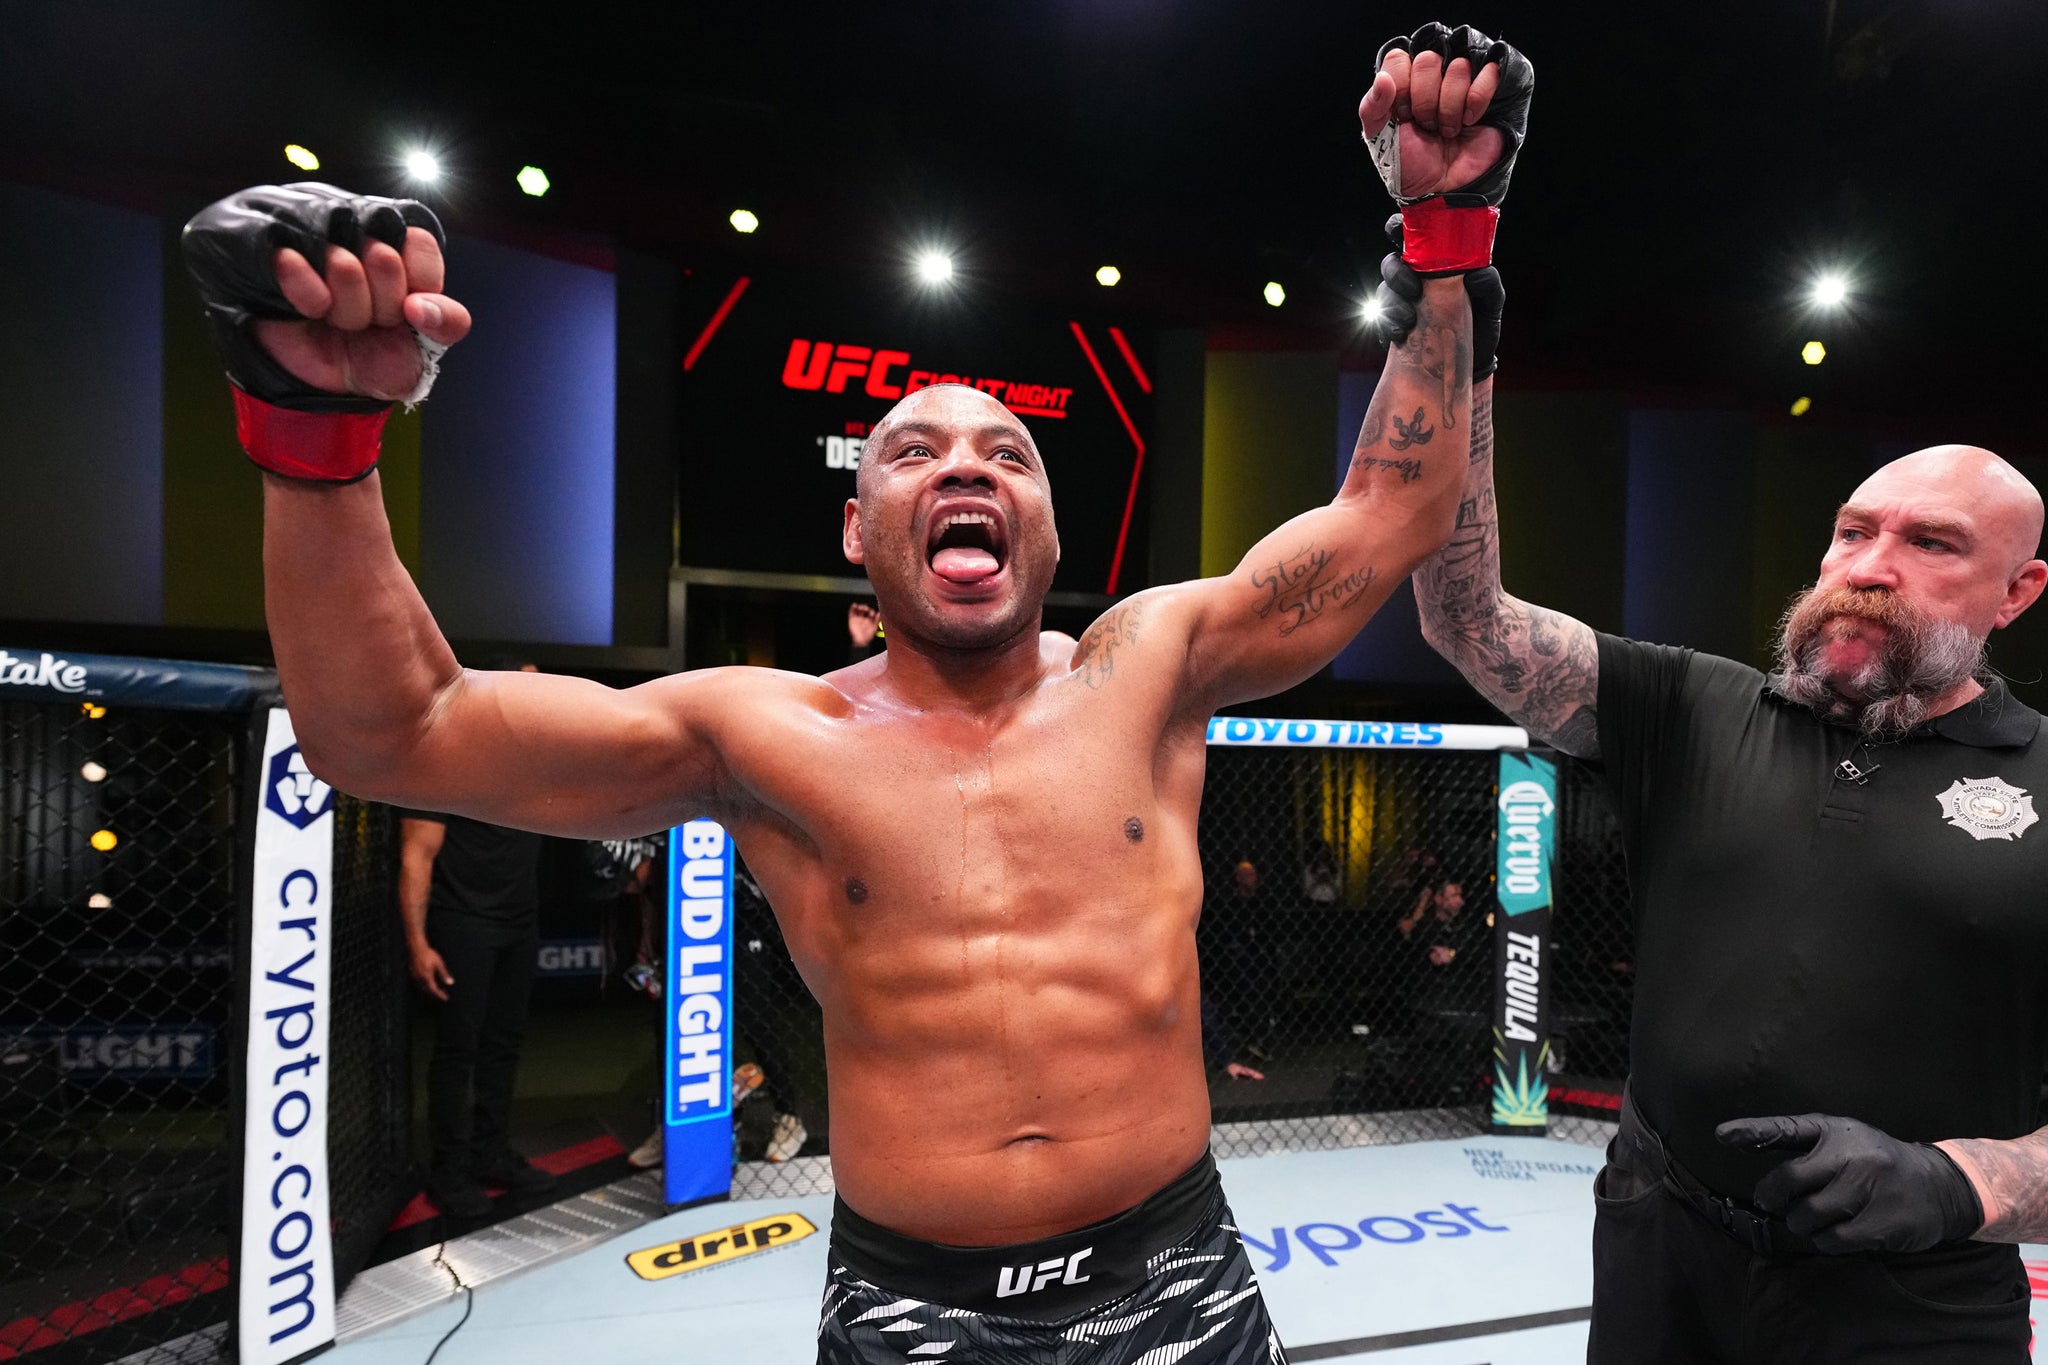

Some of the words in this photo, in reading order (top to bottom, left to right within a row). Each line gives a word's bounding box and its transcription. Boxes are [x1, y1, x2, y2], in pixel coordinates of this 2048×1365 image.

[782, 338, 910, 400] UFC
[1003, 381, 1073, 409] NIGHT
[1251, 541, 1338, 619] Stay
[1279, 566, 1376, 638] Strong
[1205, 716, 1317, 744] TOYO
[1322, 722, 1444, 745] TIRES
[1953, 801, 1974, 824] ATHLETIC
[1974, 816, 2020, 831] COMMISSION
[1963, 785, 1998, 794] NEVADA
[1999, 789, 2019, 804] STATE
[1498, 780, 1555, 894] Cuervo
[680, 820, 725, 940] BUD
[1504, 931, 1541, 1043] TEQUILA
[678, 944, 722, 1107] LIGHT
[266, 868, 320, 1345] crypto.com
[1462, 1147, 1504, 1160] NEW
[1470, 1158, 1596, 1176] AMSTERDAM
[1474, 1168, 1538, 1182] VODKA
[653, 1220, 792, 1267] drip
[996, 1246, 1093, 1298] UFC
